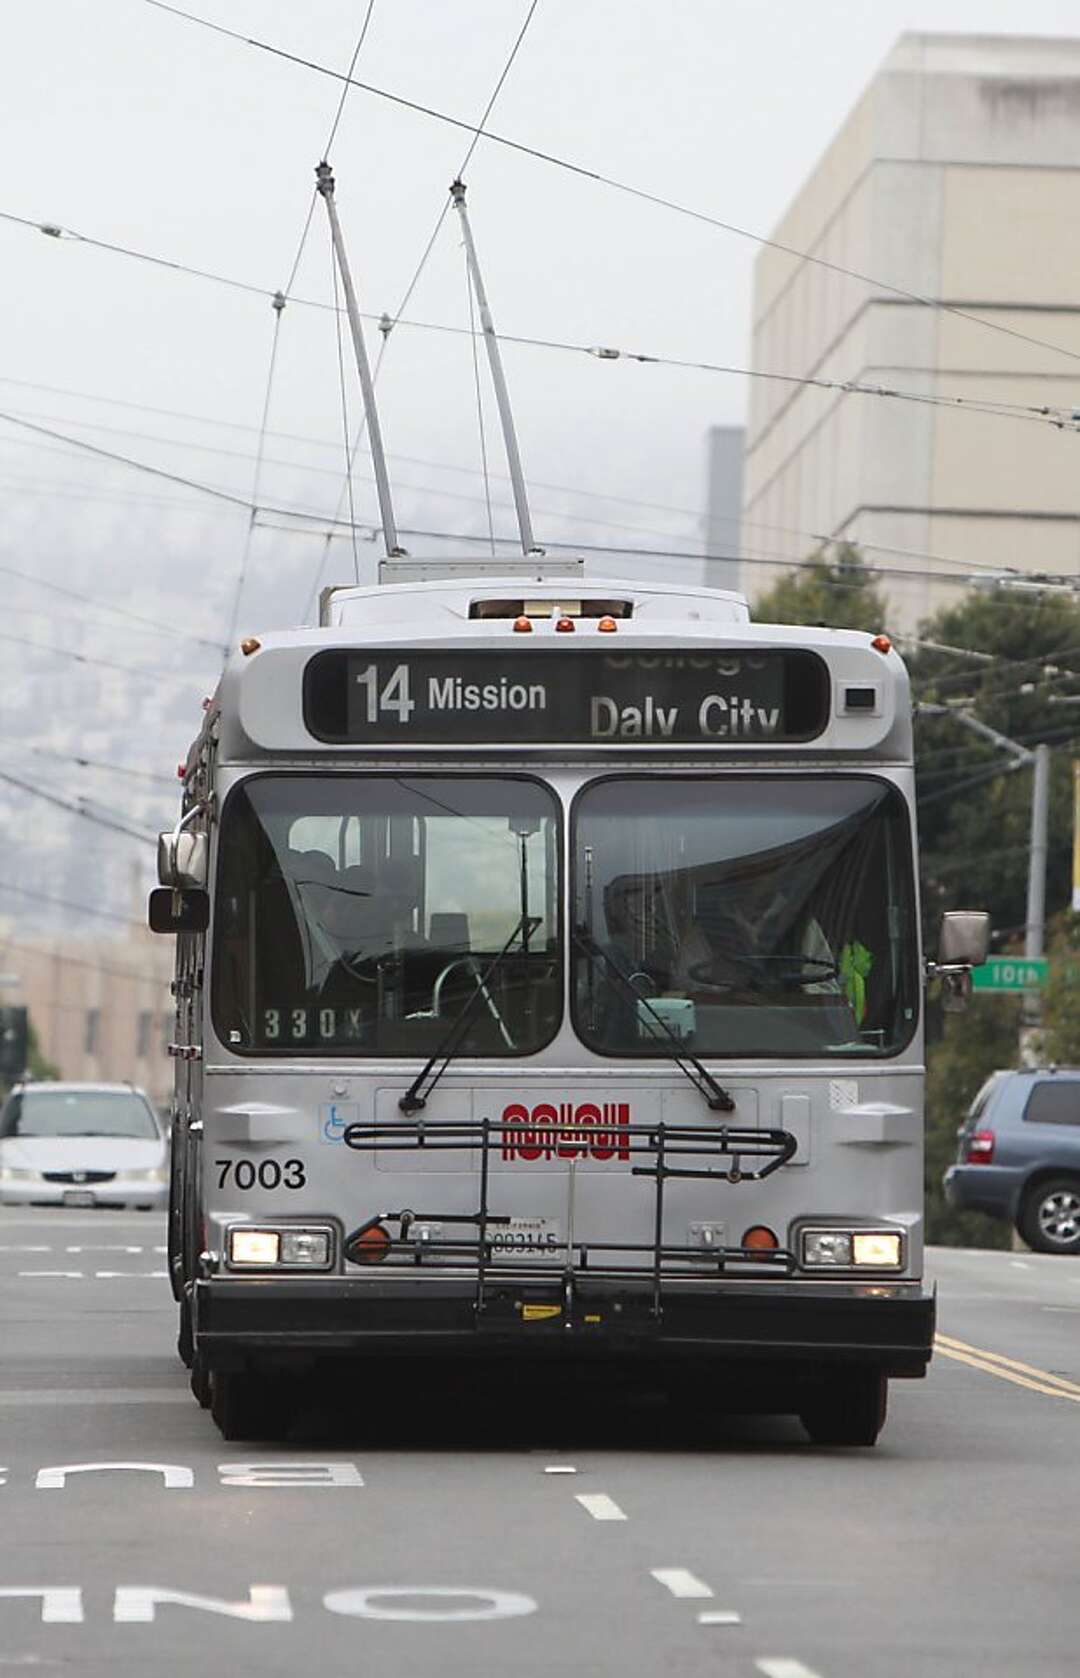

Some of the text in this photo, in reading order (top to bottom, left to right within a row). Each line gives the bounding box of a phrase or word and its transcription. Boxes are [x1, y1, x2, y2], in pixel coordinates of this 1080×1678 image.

[357, 664, 546, 723] 14 Mission
[591, 694, 779, 737] Daly City
[993, 964, 1038, 985] 10th
[215, 1158, 306, 1190] 7003
